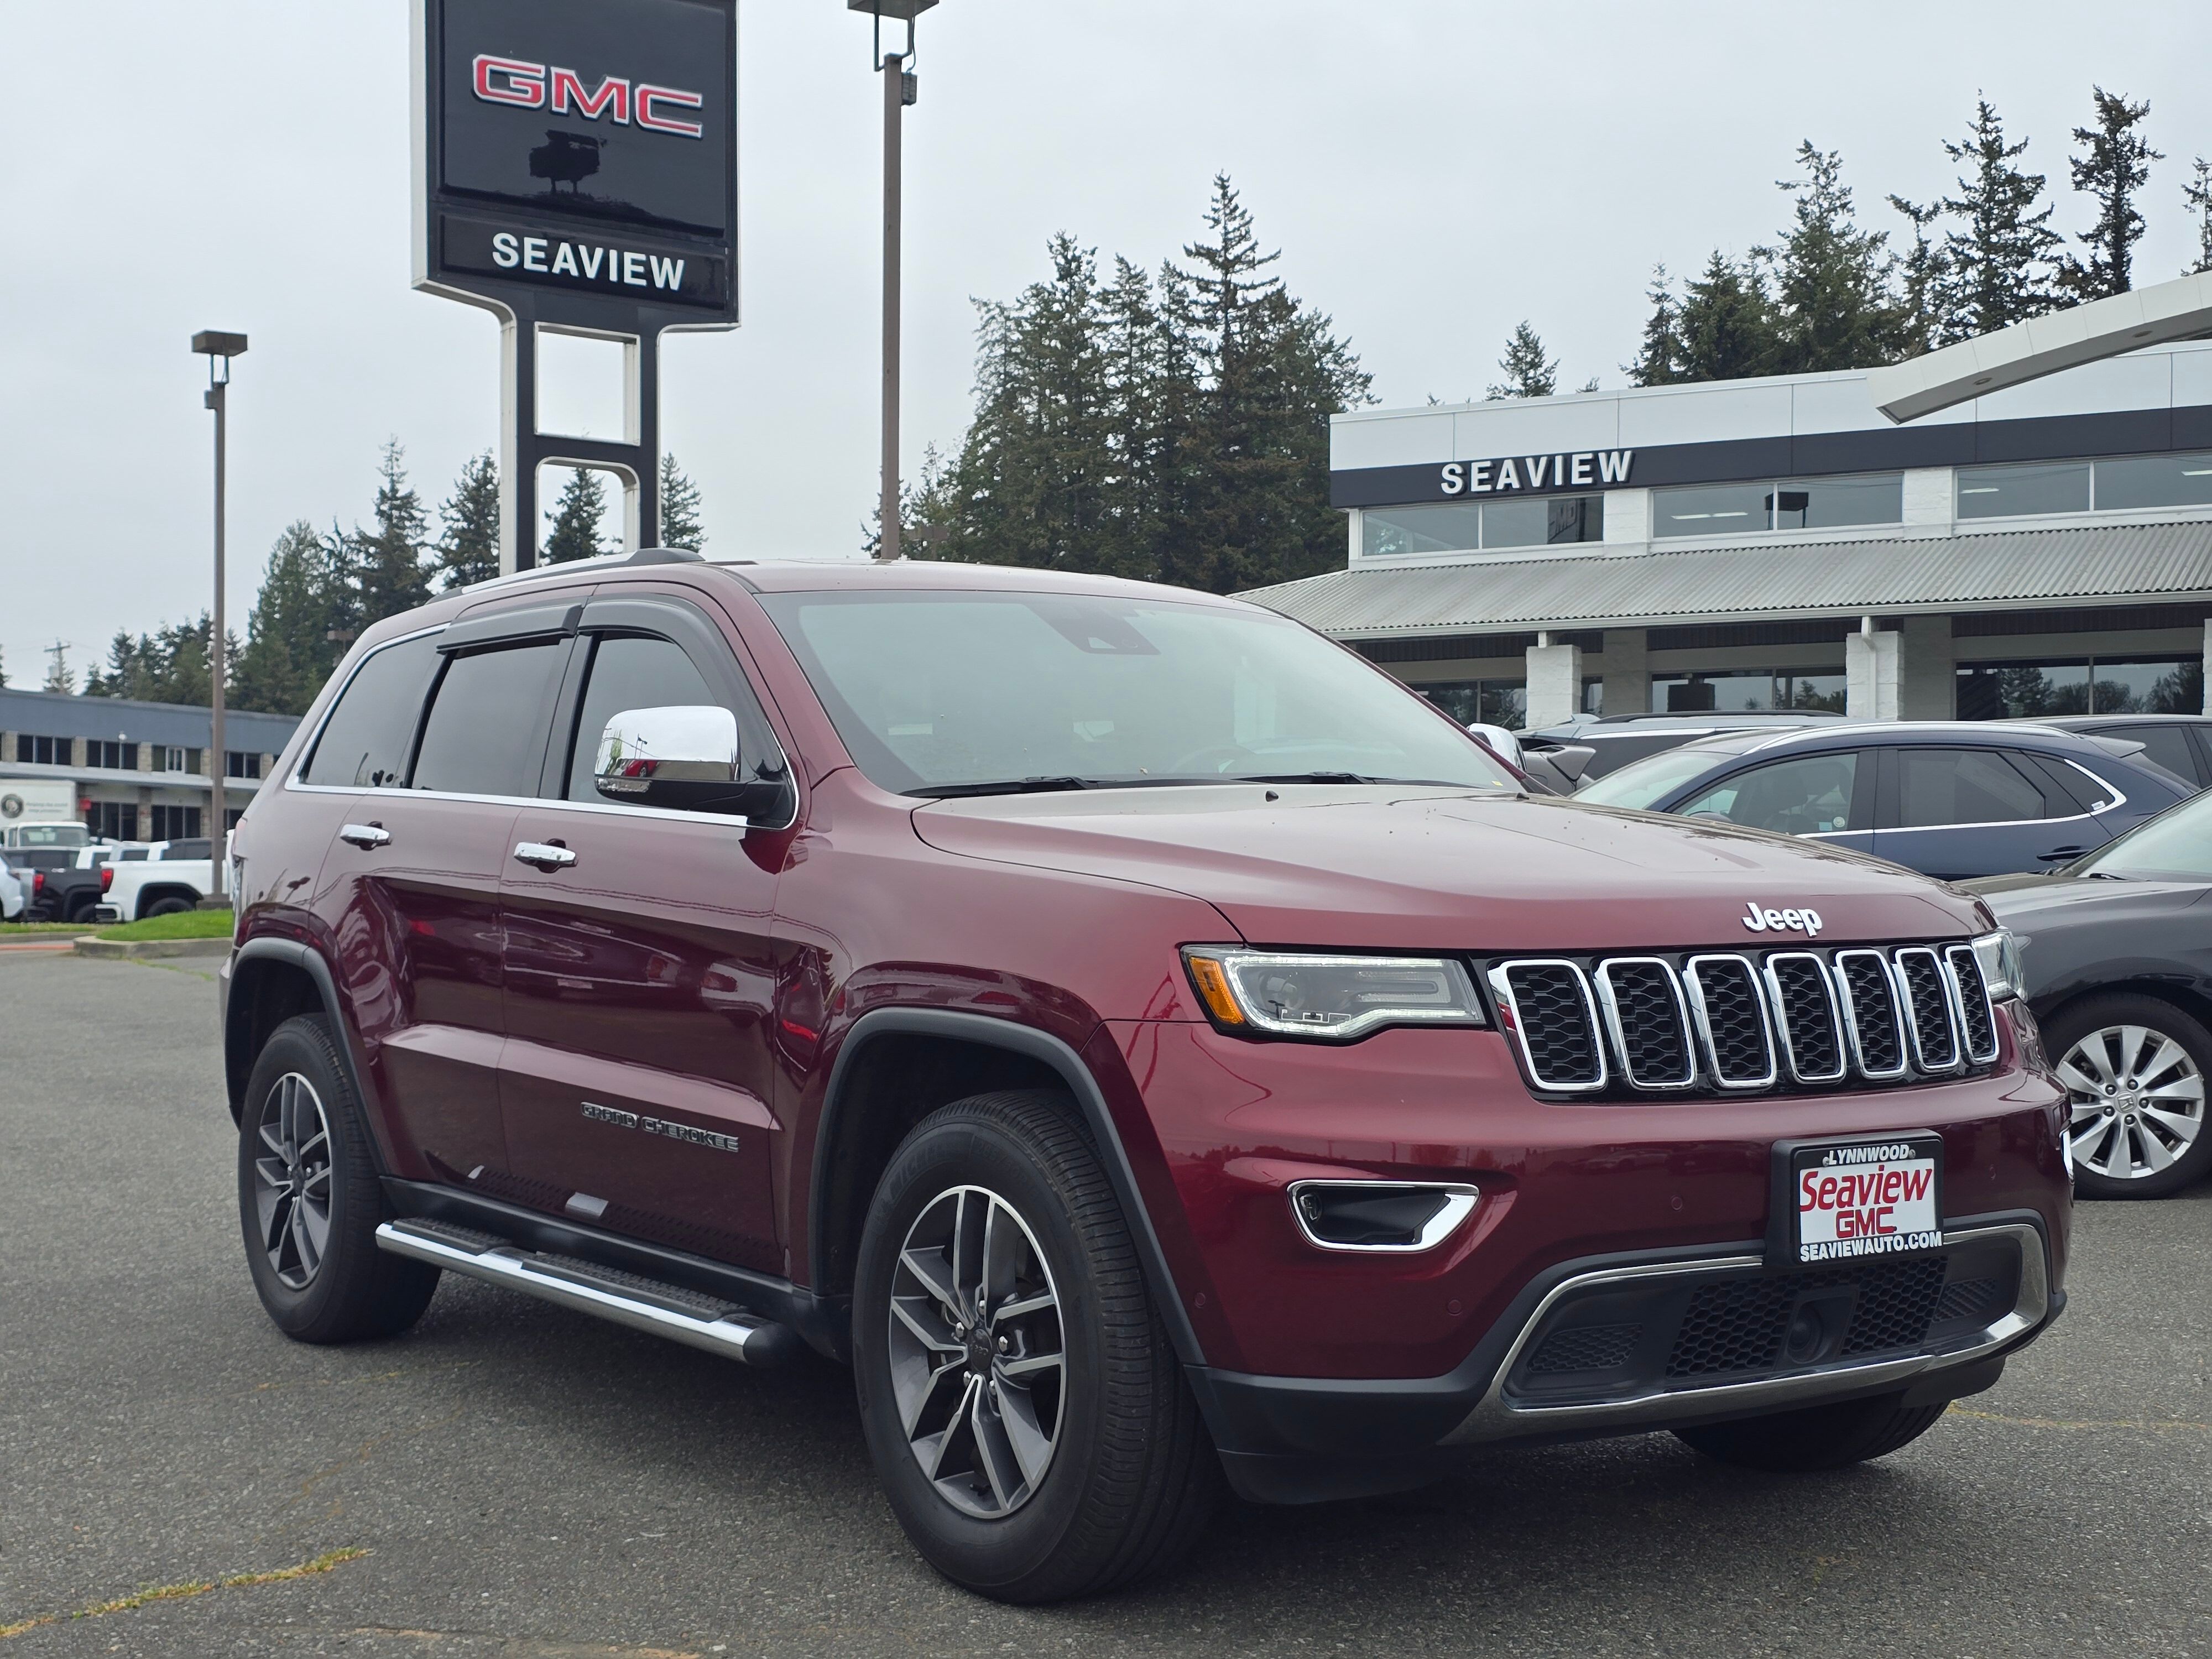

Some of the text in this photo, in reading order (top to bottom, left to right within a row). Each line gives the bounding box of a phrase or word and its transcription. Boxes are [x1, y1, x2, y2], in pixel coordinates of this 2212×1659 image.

[472, 54, 703, 138] GMC
[492, 232, 684, 291] SEAVIEW
[1441, 450, 1632, 494] SEAVIEW
[1741, 902, 1822, 938] Jeep
[581, 1102, 739, 1153] GRAND CHEROKEE
[1829, 1144, 1909, 1165] LYNNWOOD
[1800, 1164, 1932, 1212] Seaview
[1835, 1206, 1897, 1238] GMC
[1800, 1231, 1942, 1262] SEAVIEWAUTO.COM
